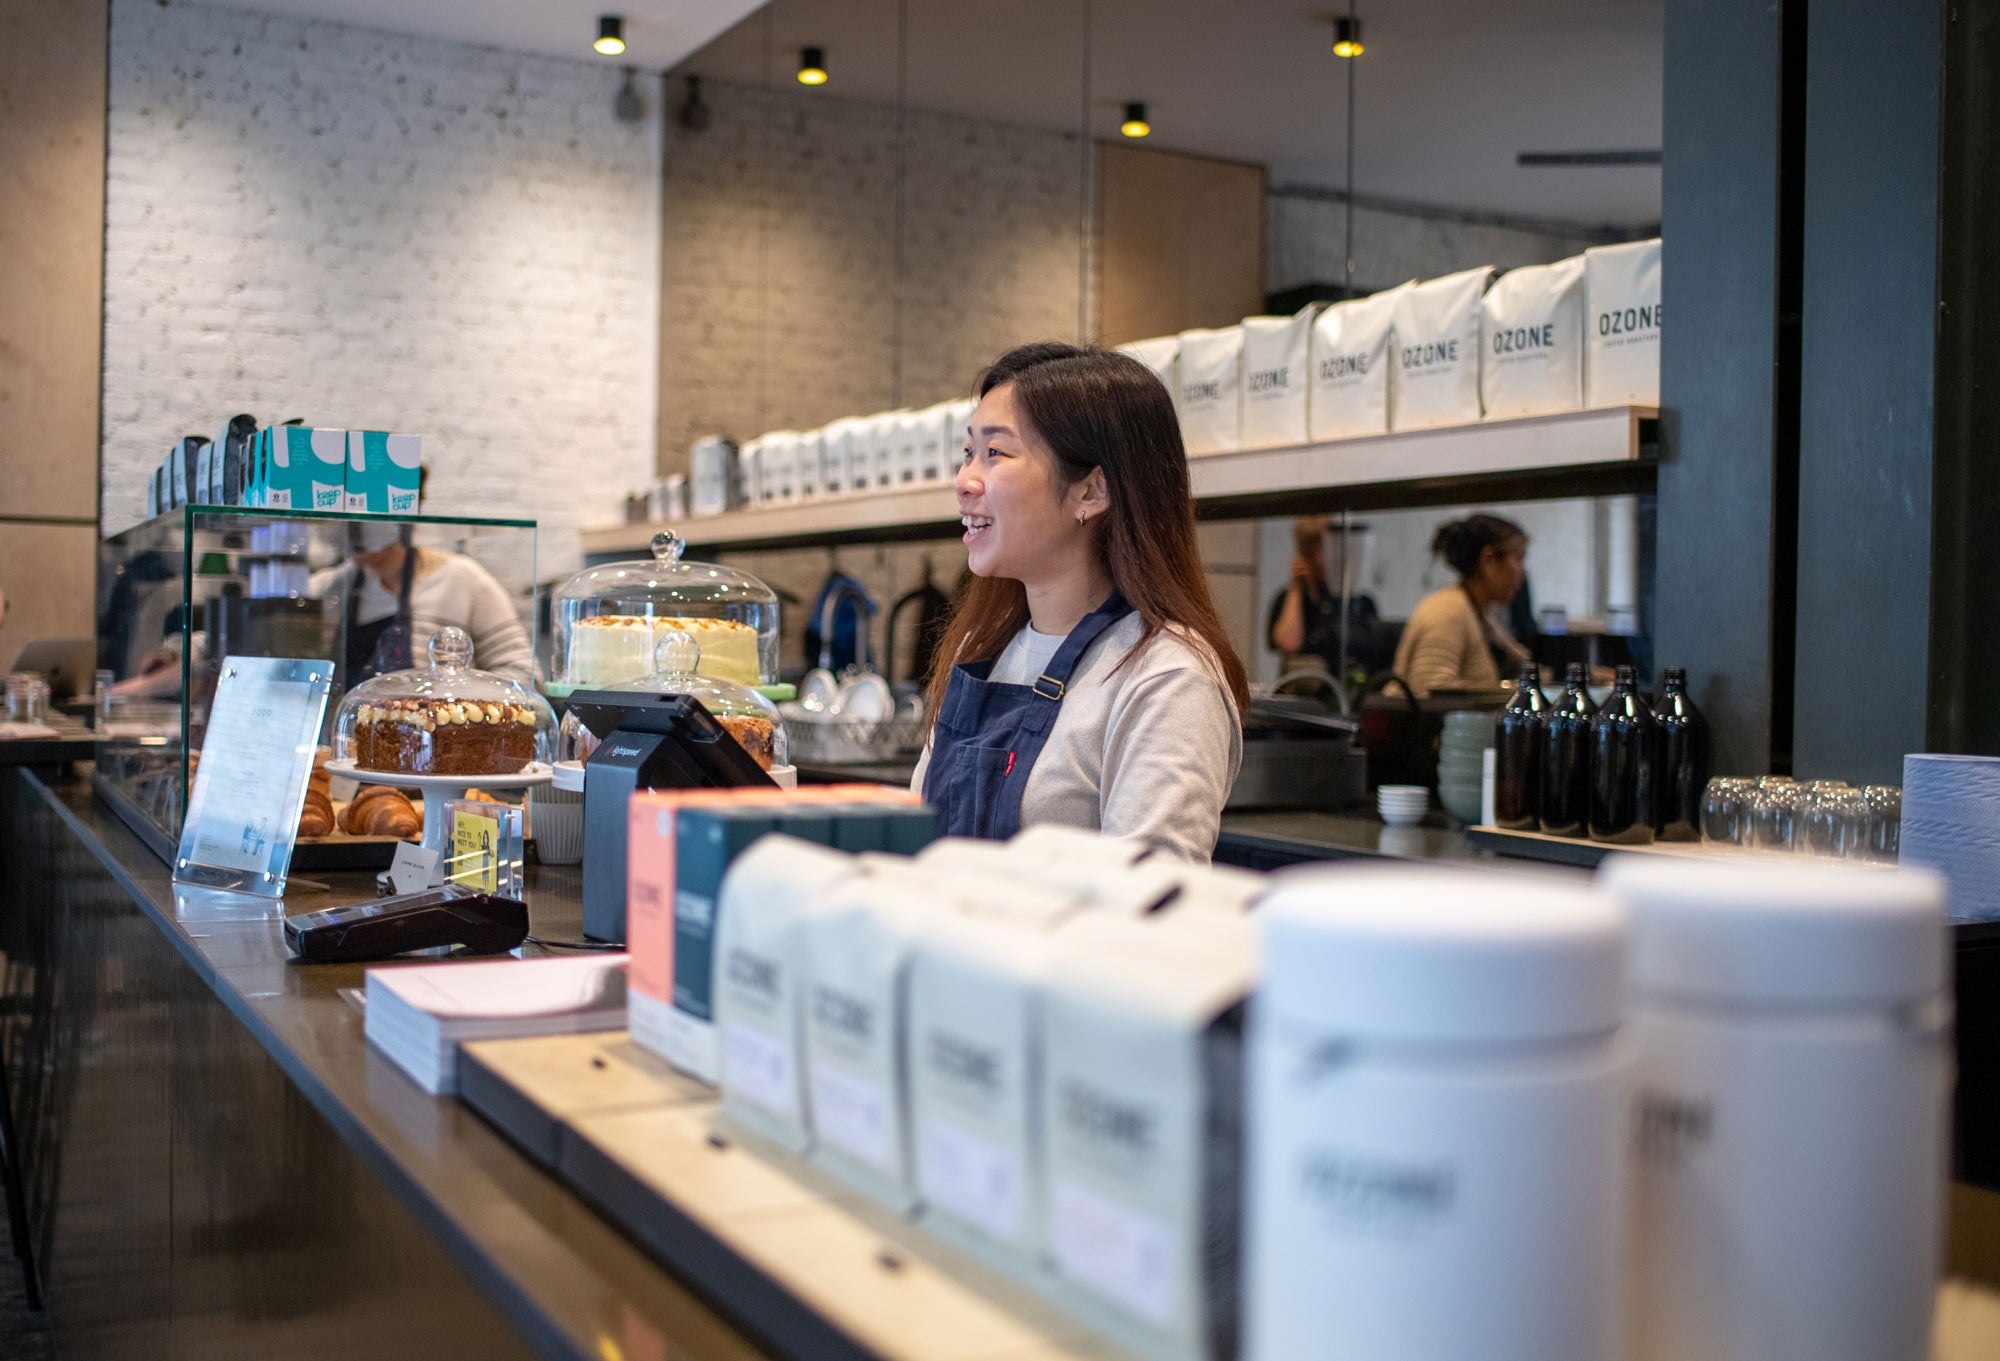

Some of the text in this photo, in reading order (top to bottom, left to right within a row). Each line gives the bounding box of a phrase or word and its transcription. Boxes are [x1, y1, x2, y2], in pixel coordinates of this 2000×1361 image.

[1599, 304, 1663, 337] OZONE
[1402, 338, 1459, 370] OZONE
[1493, 323, 1554, 355] OZONE
[317, 489, 341, 500] keep
[392, 493, 416, 504] keep
